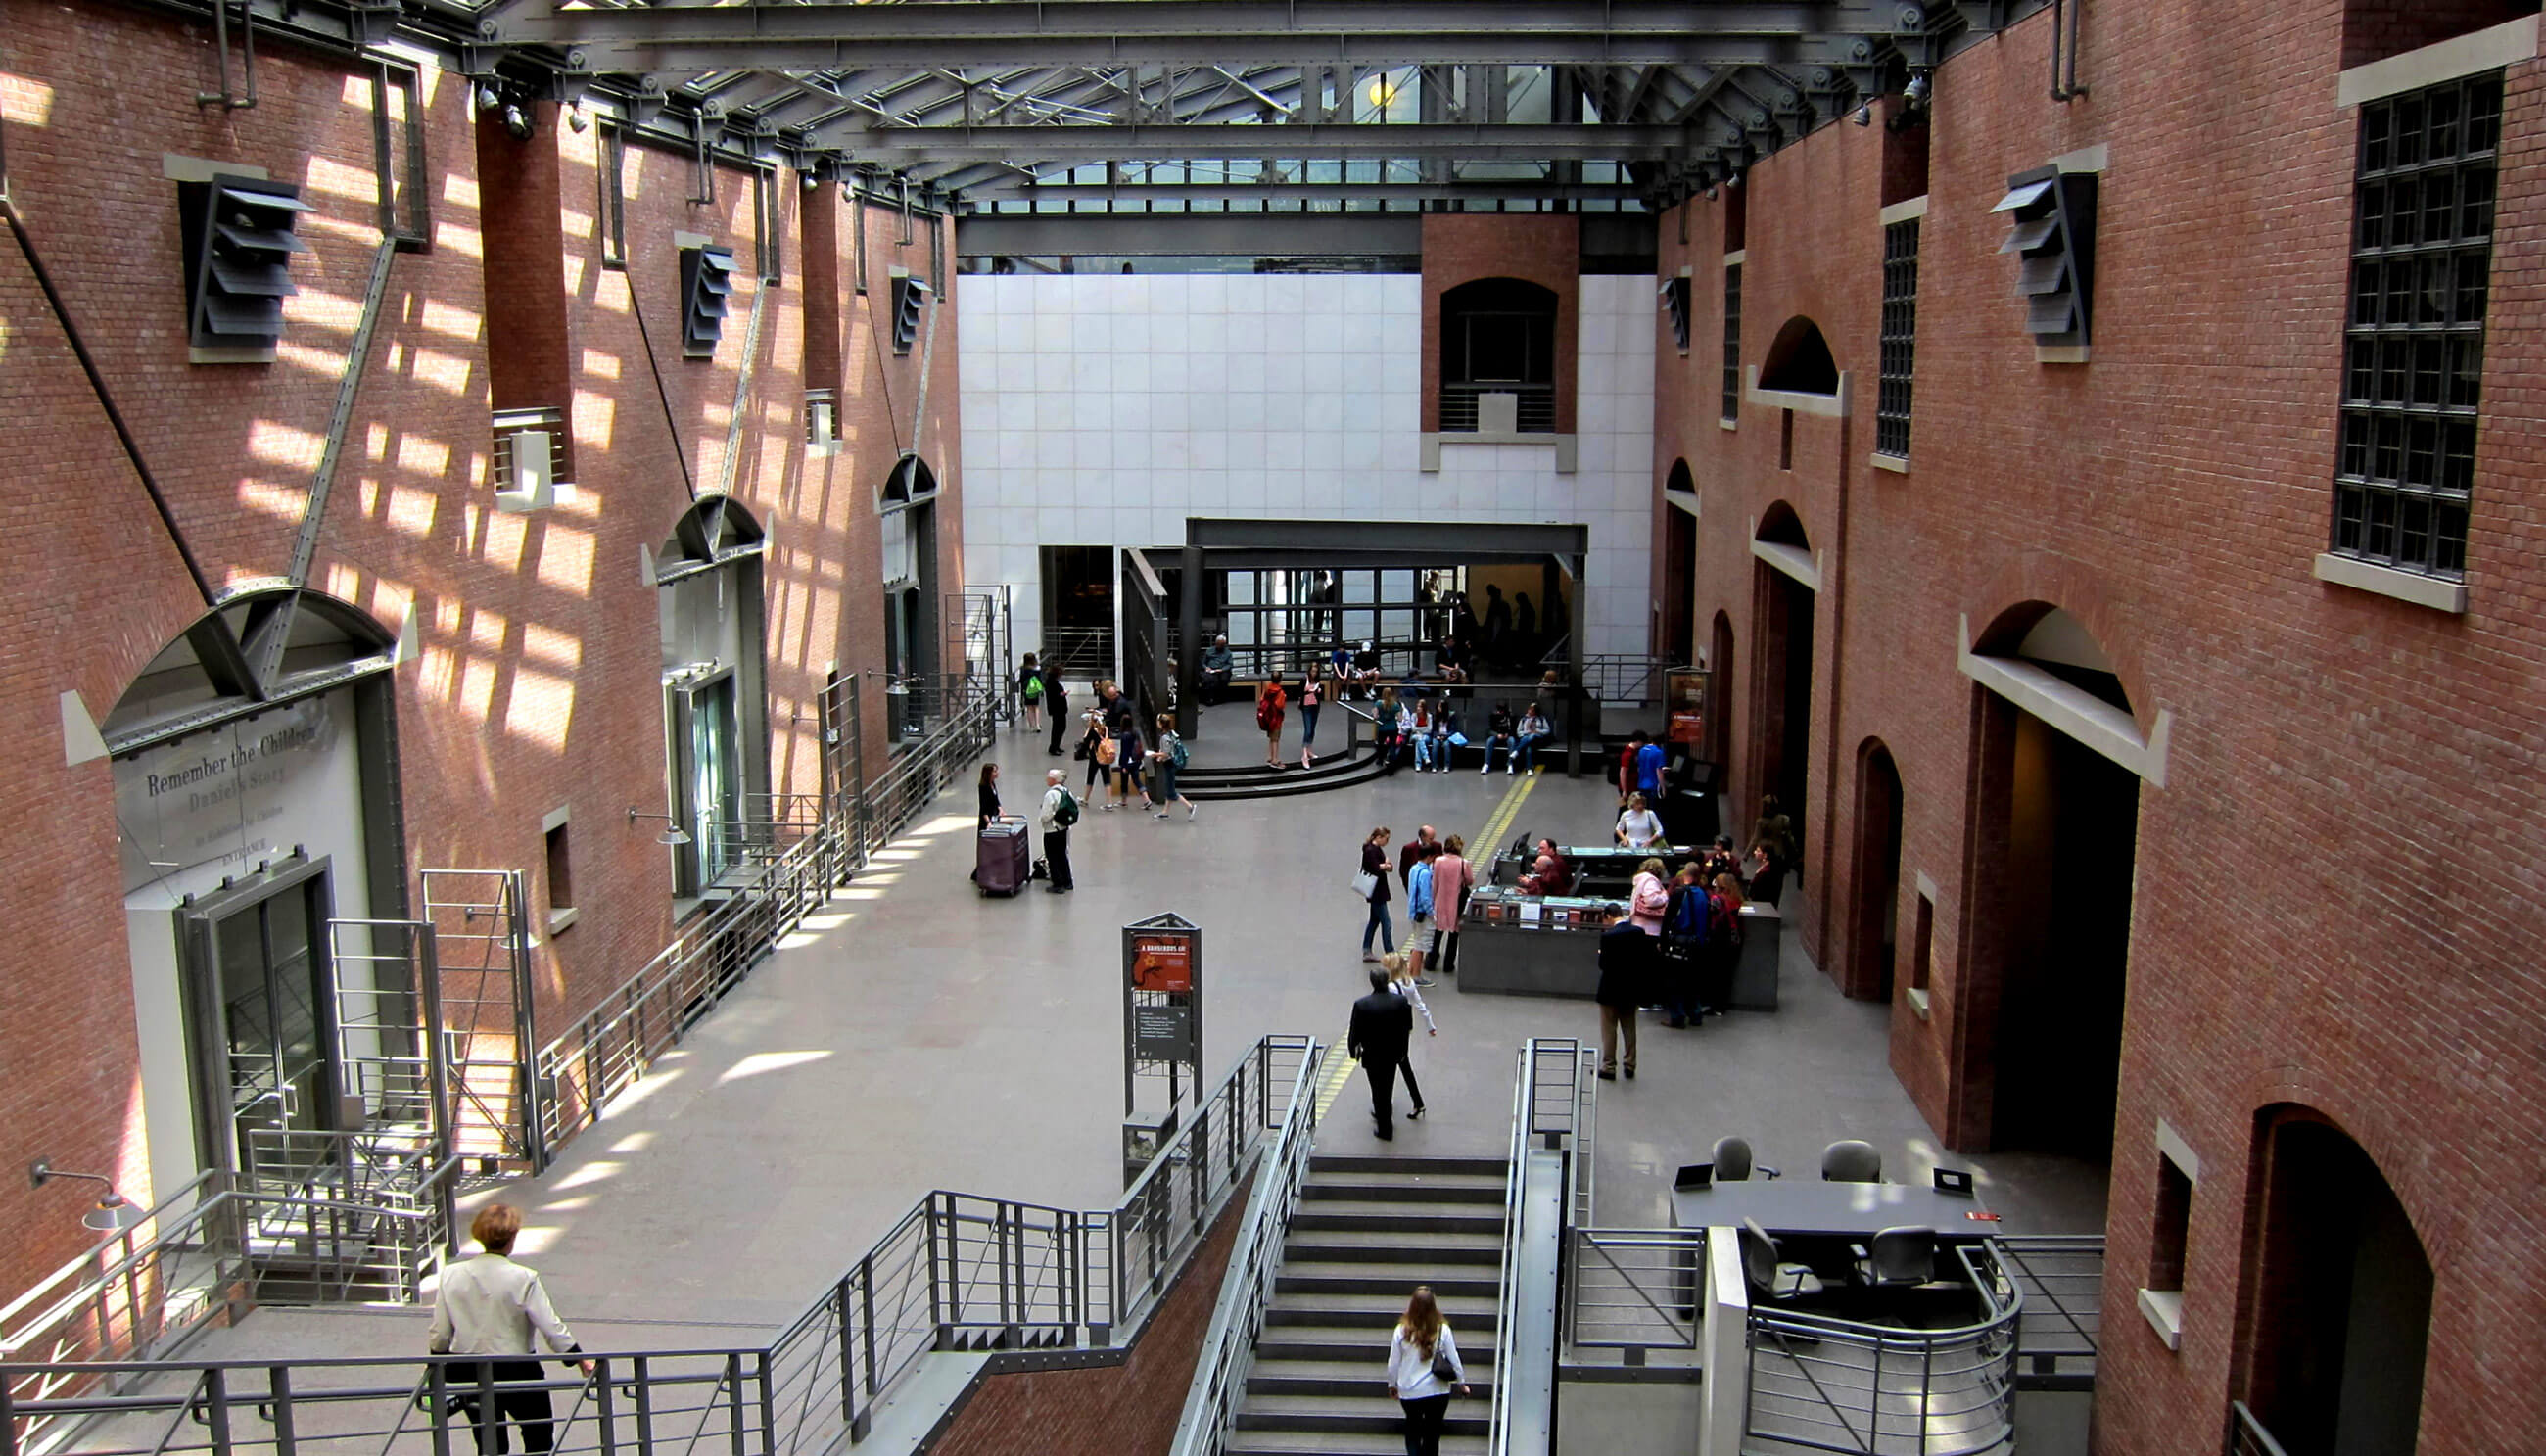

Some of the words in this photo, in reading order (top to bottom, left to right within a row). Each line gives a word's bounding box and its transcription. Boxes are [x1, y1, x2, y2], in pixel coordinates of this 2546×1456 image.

[148, 757, 227, 797] Remember
[231, 744, 255, 769] the
[260, 727, 315, 757] Children
[250, 767, 284, 790] Story
